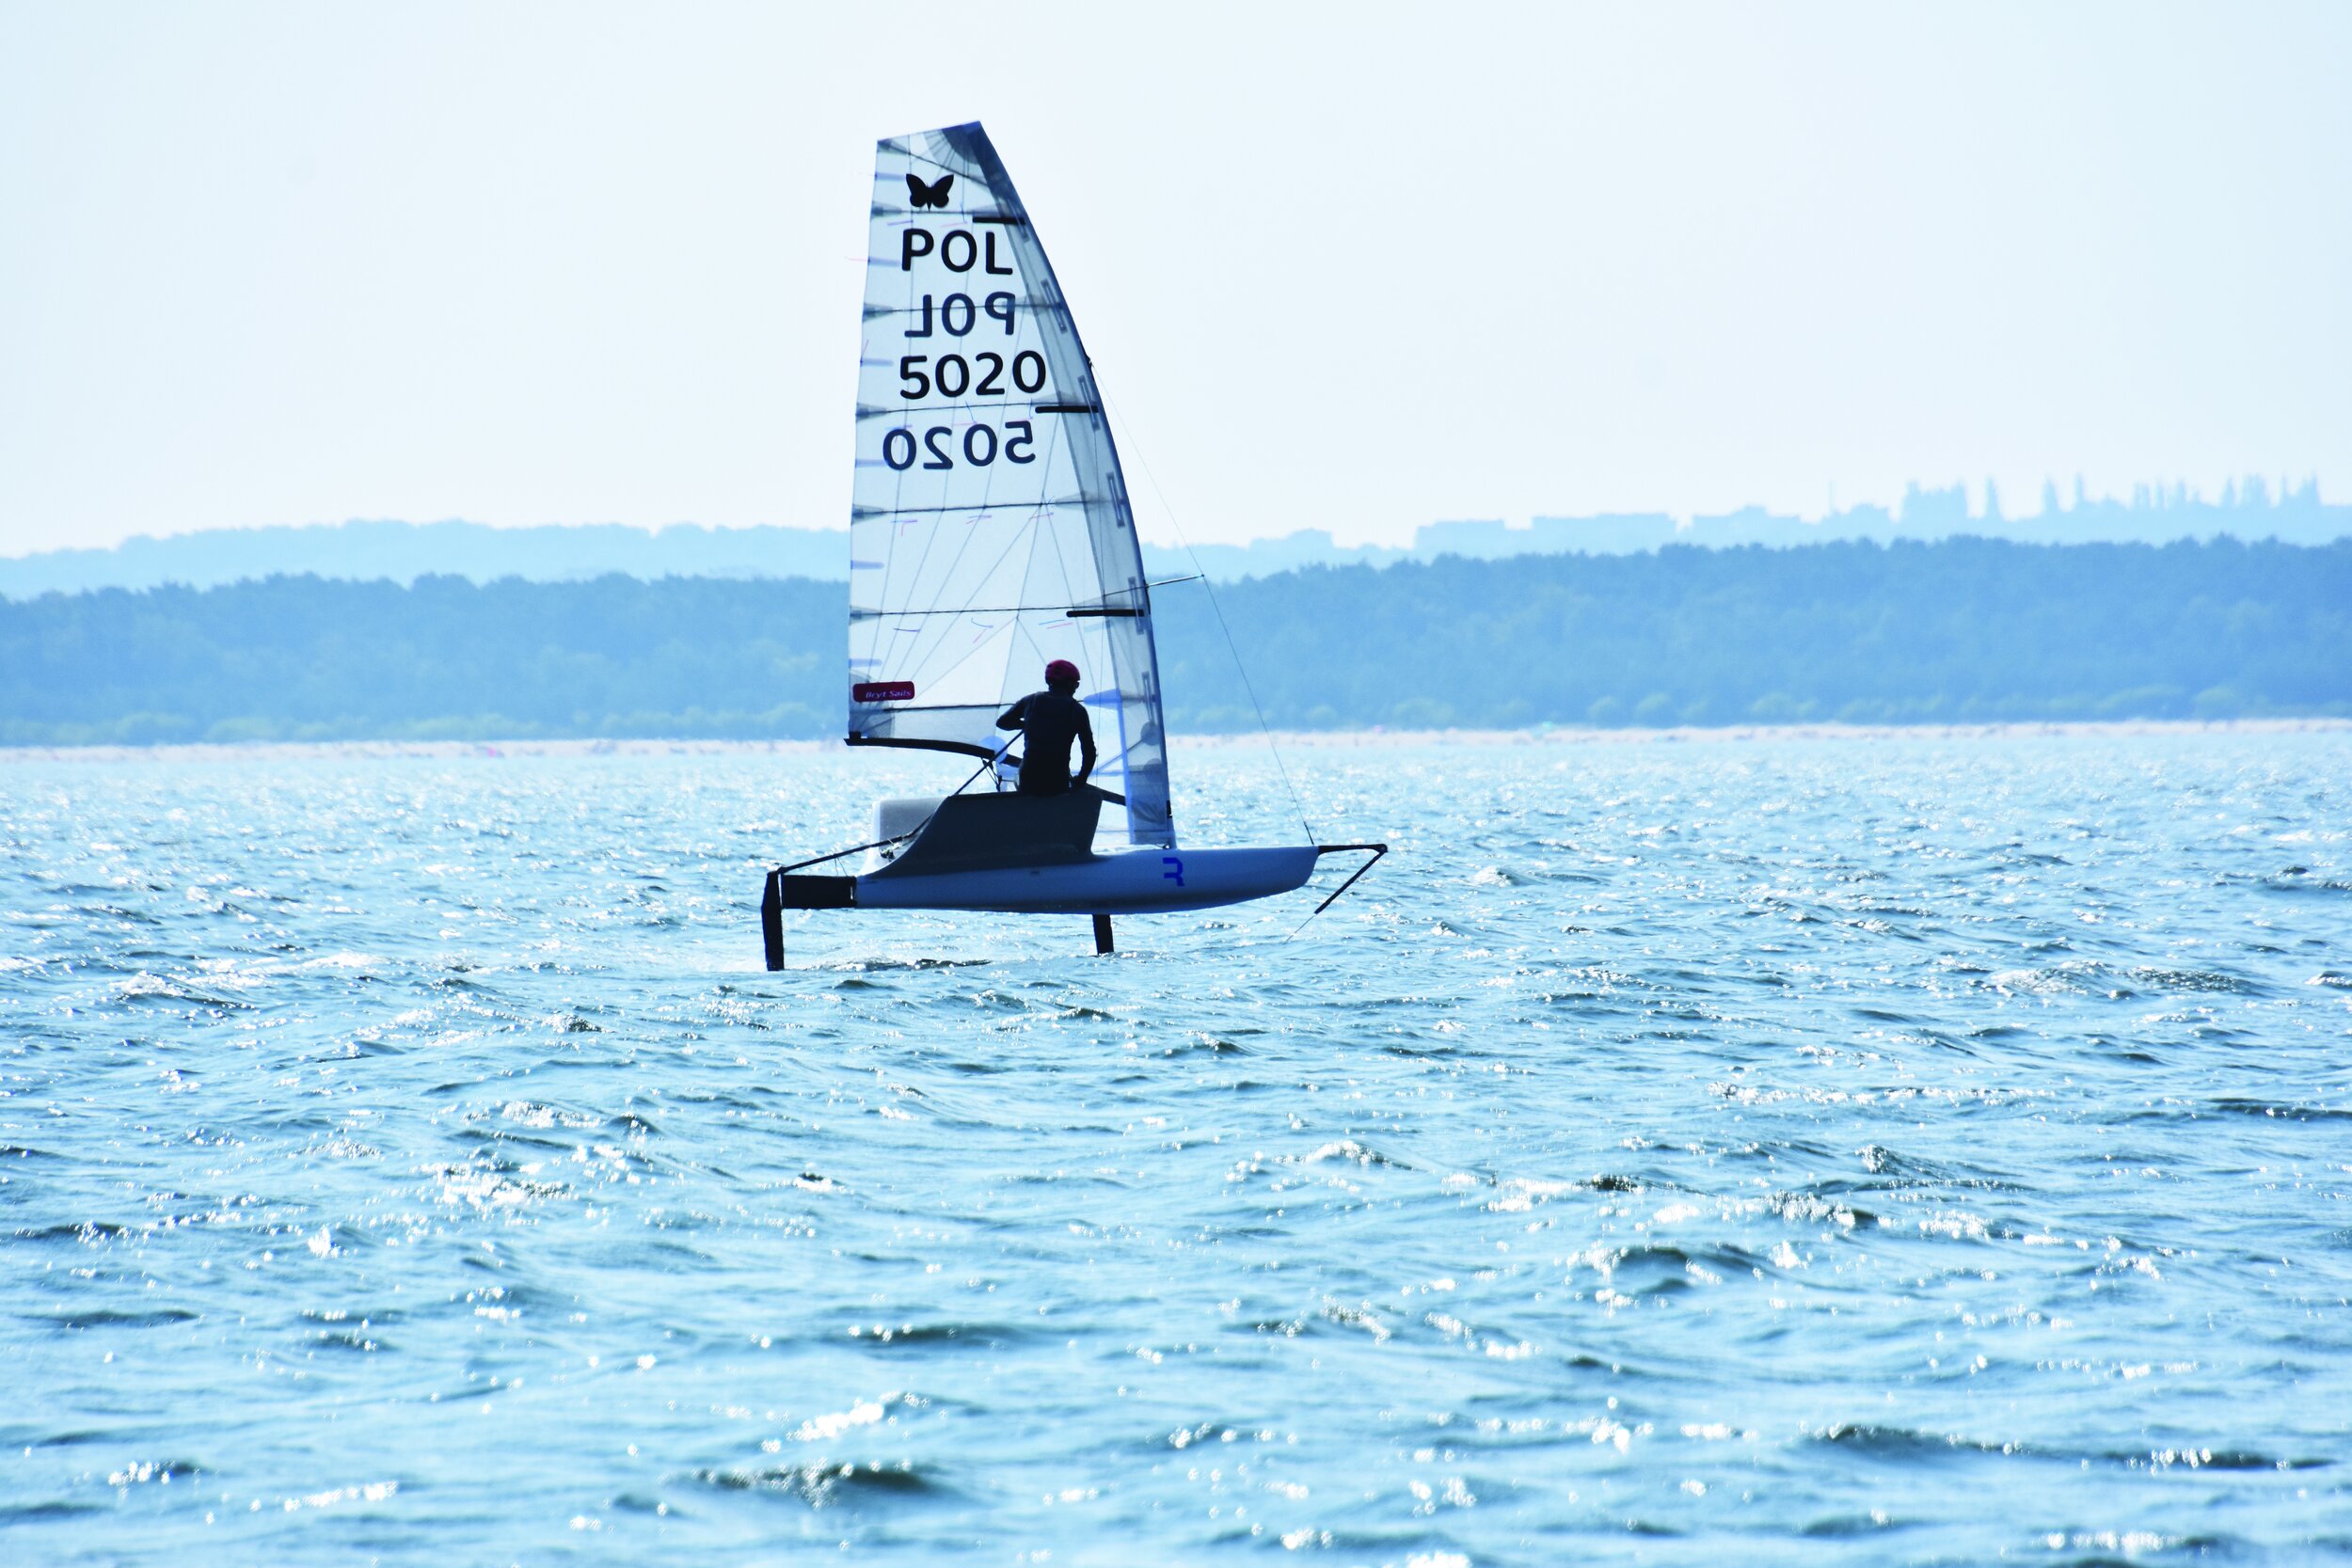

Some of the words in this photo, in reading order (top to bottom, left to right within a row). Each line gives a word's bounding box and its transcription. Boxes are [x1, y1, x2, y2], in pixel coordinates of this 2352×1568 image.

[901, 228, 1013, 276] POL
[899, 350, 1046, 400] 5020
[888, 689, 912, 698] Sails
